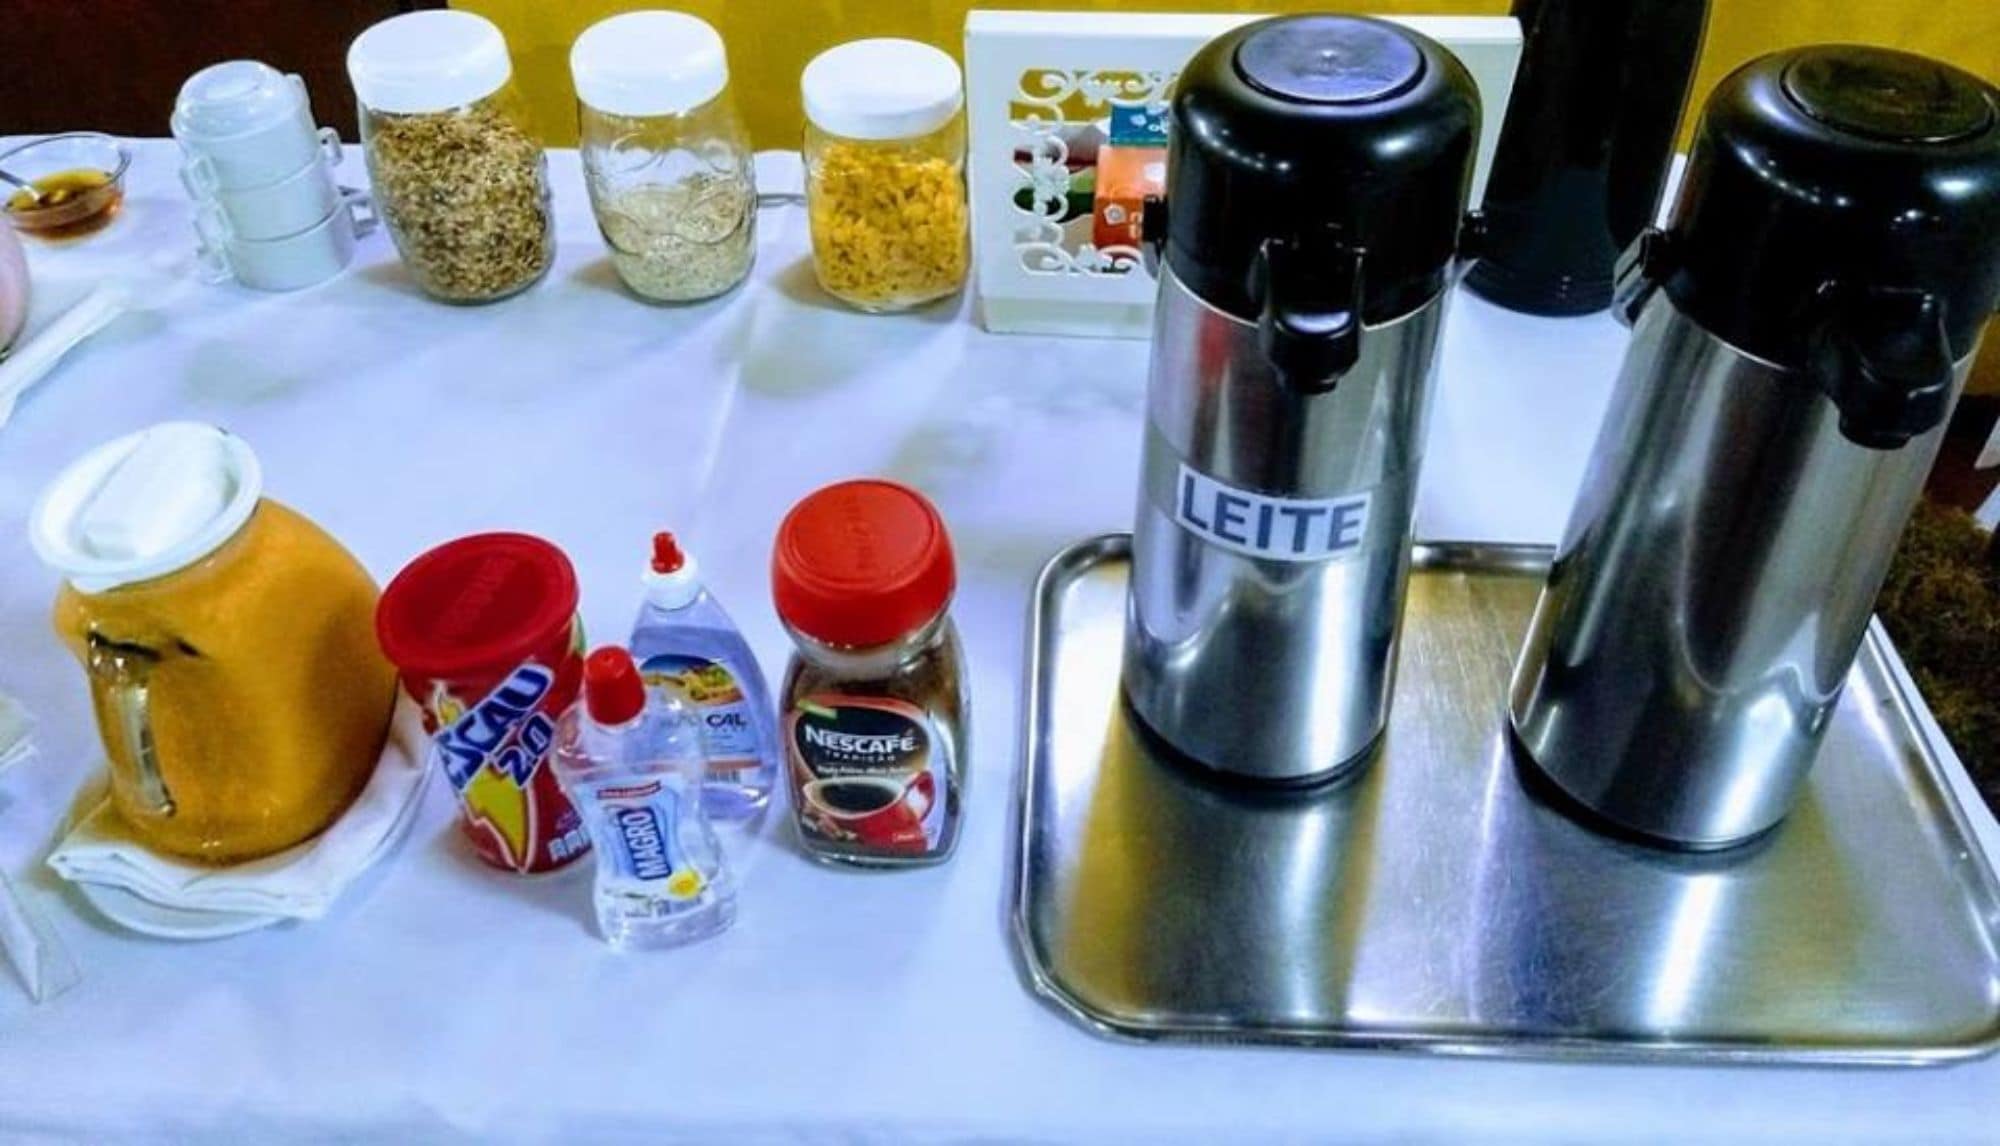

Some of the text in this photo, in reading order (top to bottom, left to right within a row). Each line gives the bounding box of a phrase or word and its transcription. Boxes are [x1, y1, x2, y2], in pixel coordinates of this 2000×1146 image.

[1183, 474, 1366, 553] LEITE
[498, 713, 552, 787] 2.0
[621, 811, 670, 878] MAGRO
